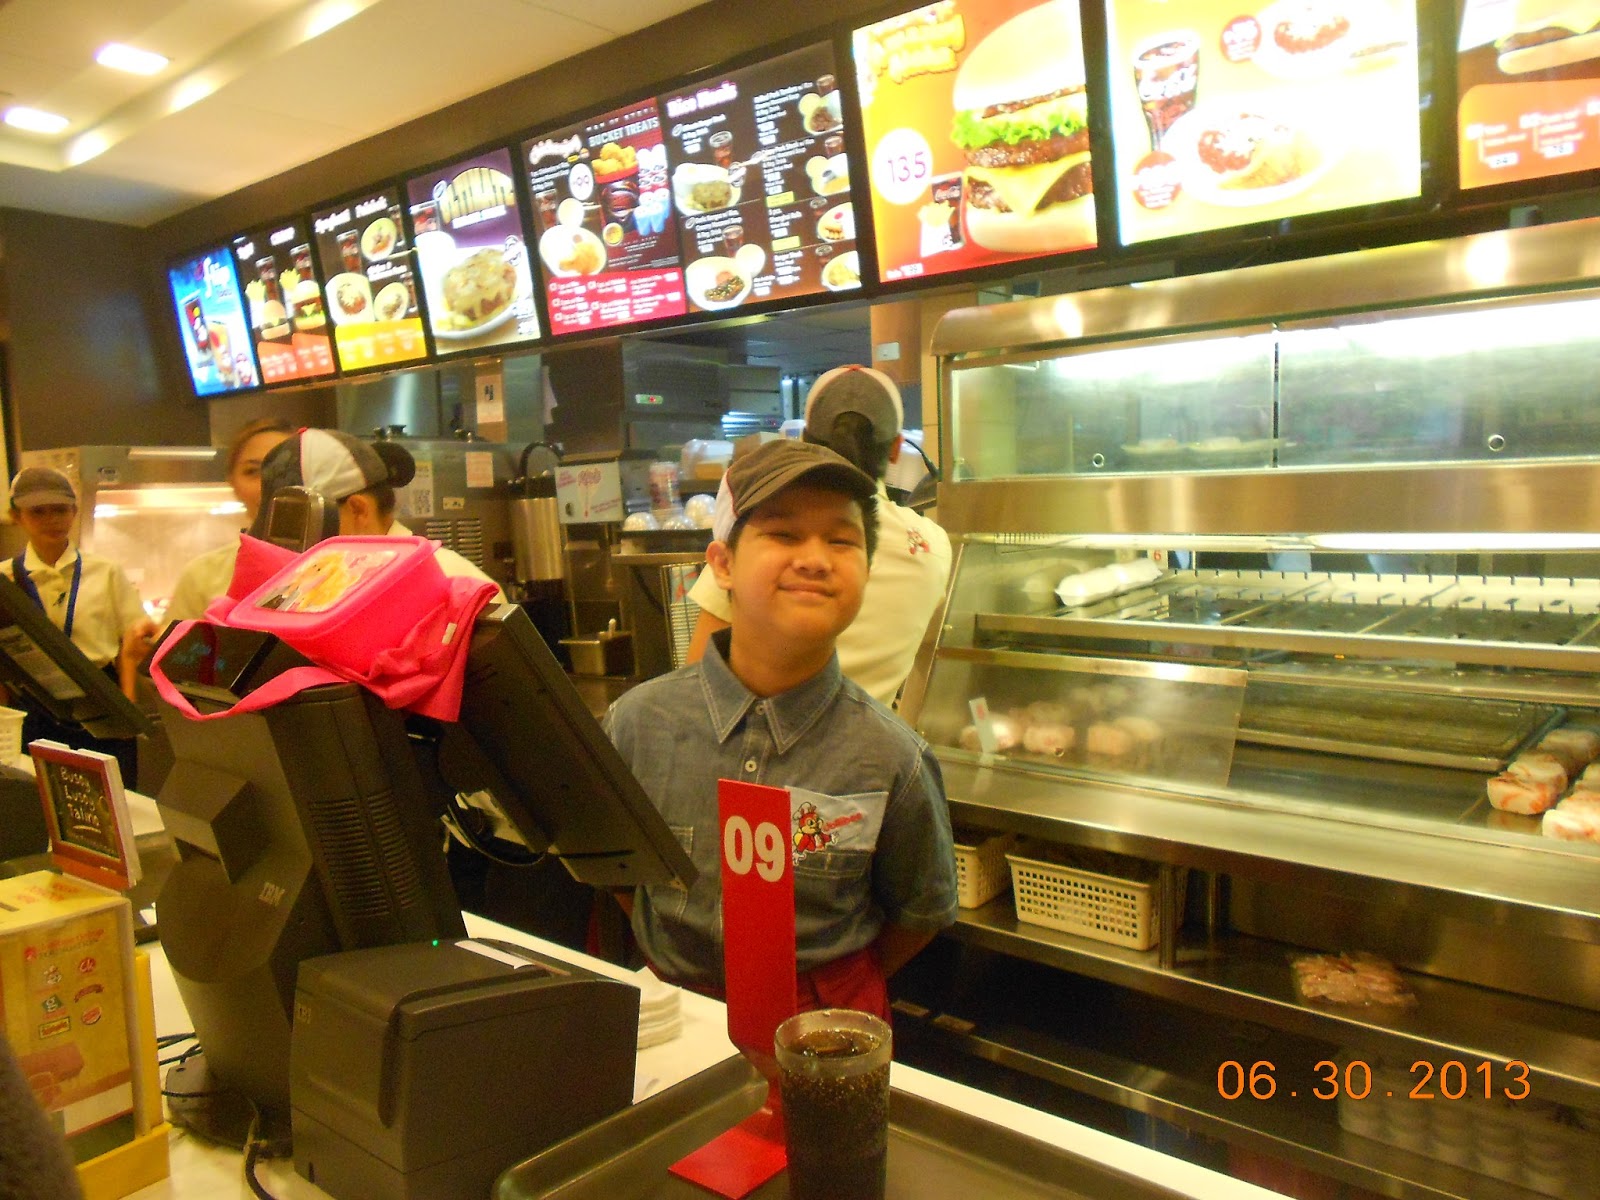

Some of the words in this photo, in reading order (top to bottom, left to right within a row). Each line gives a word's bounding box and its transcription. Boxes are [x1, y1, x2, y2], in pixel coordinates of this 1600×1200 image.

[588, 127, 625, 147] BUCKET
[624, 116, 660, 136] TREATS
[887, 151, 926, 183] 135
[724, 815, 786, 883] 09
[258, 881, 286, 907] IBM
